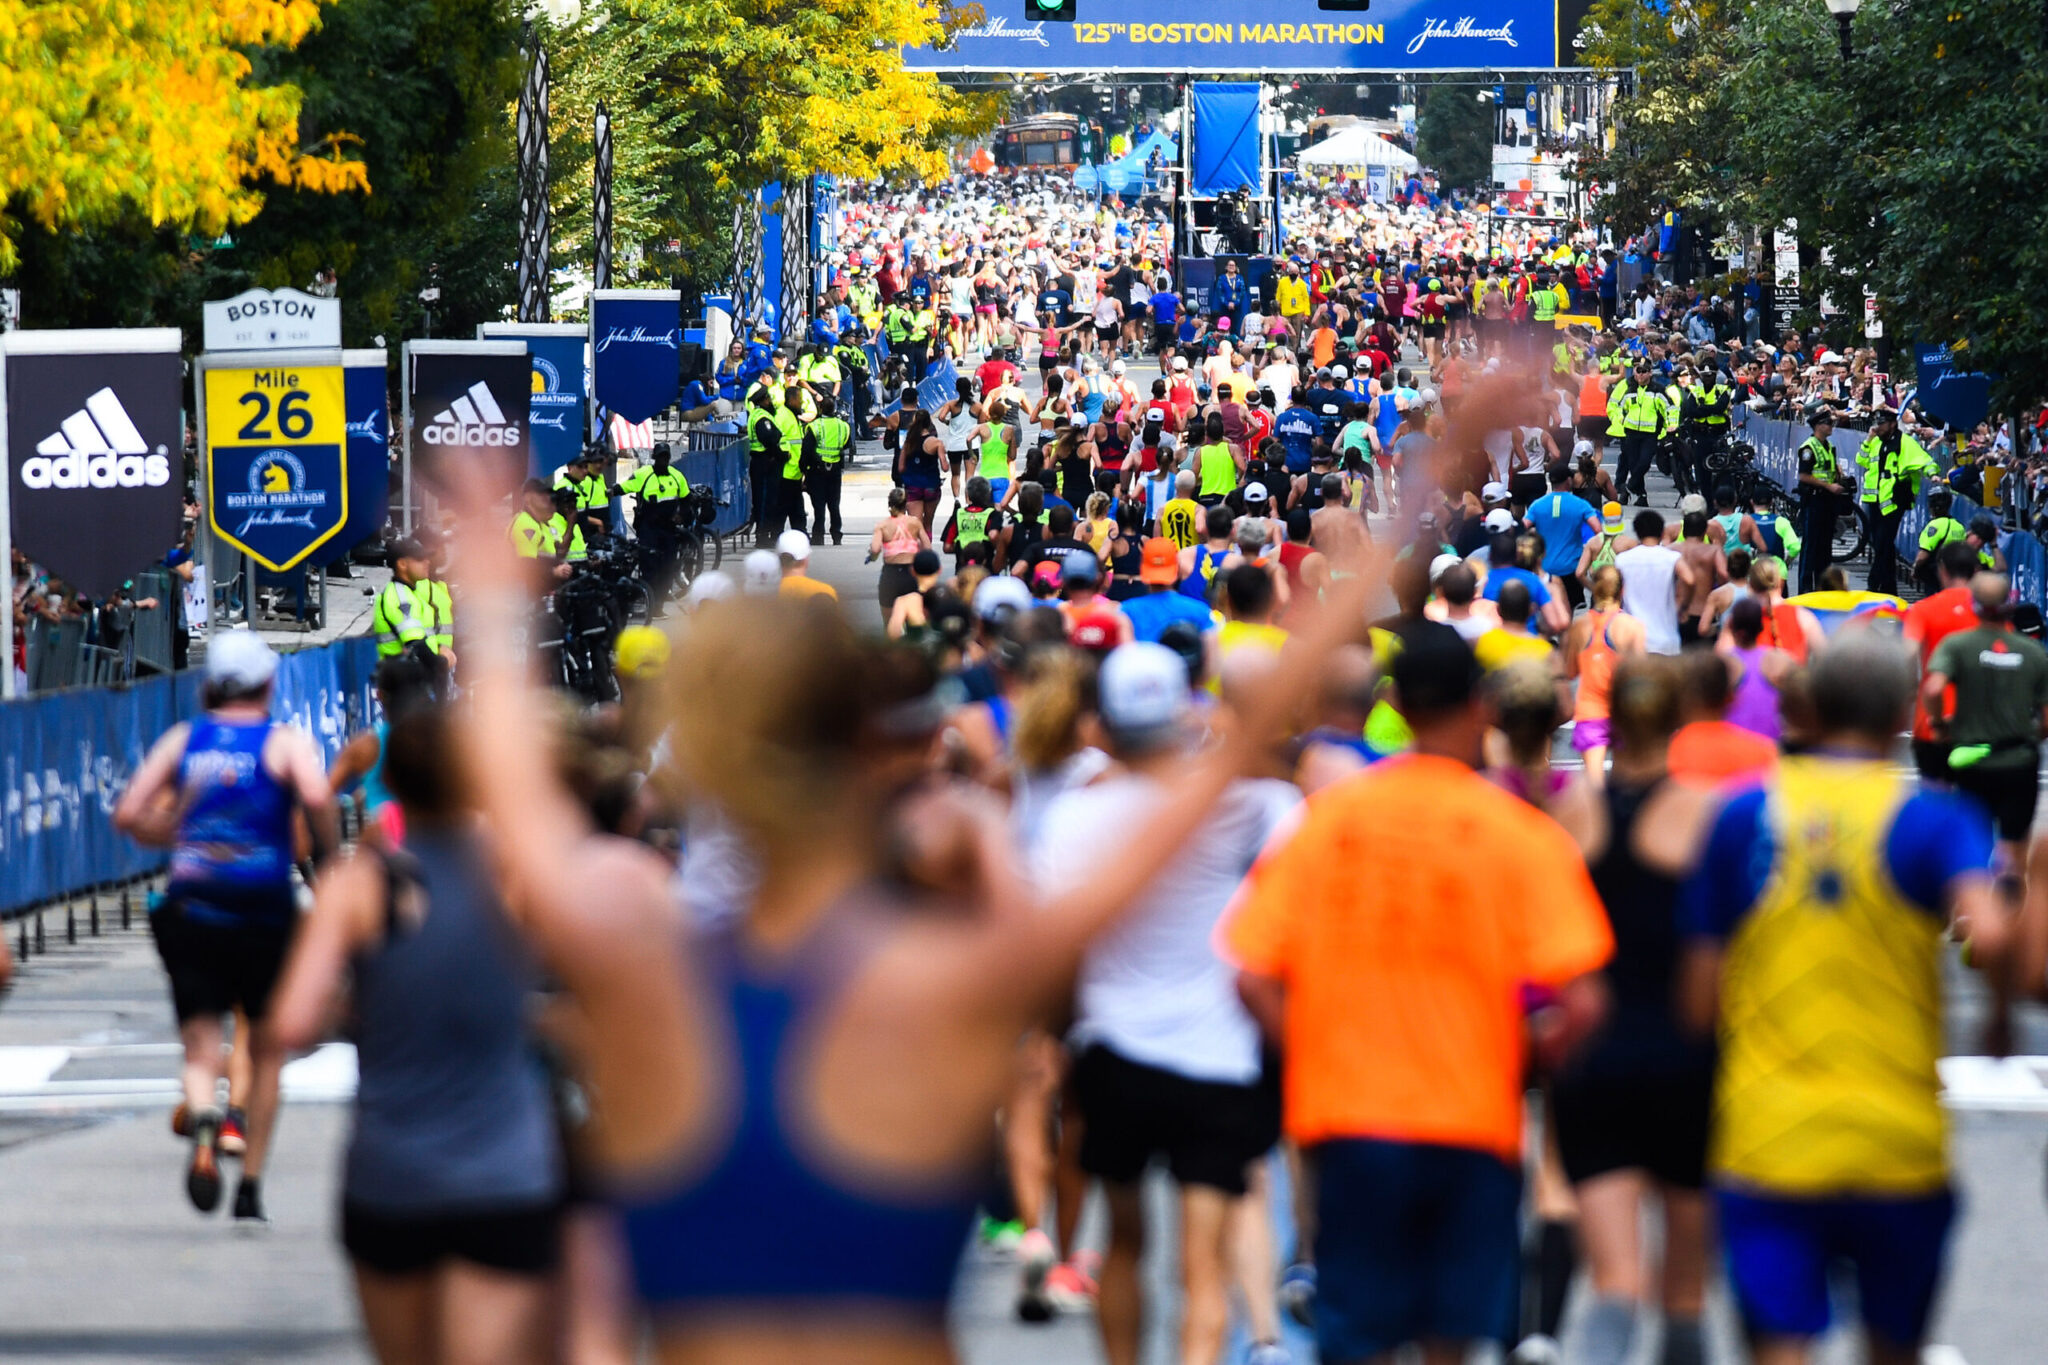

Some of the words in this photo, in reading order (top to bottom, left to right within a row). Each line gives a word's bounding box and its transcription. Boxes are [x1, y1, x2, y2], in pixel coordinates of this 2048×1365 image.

[980, 16, 1050, 47] Hancock
[1072, 23, 1126, 43] 125TH
[1130, 23, 1233, 43] BOSTON
[1240, 24, 1385, 44] MARATHON
[1406, 17, 1451, 54] John
[1450, 16, 1518, 47] Hancock
[227, 300, 316, 322] BOSTON
[596, 326, 628, 353] John
[628, 325, 677, 349] Hancock
[254, 370, 300, 388] Mile
[238, 390, 314, 440] 26
[423, 422, 520, 447] adidas
[21, 449, 170, 489] adidas
[227, 494, 268, 507] BOSTON
[270, 492, 326, 505] MARATHON
